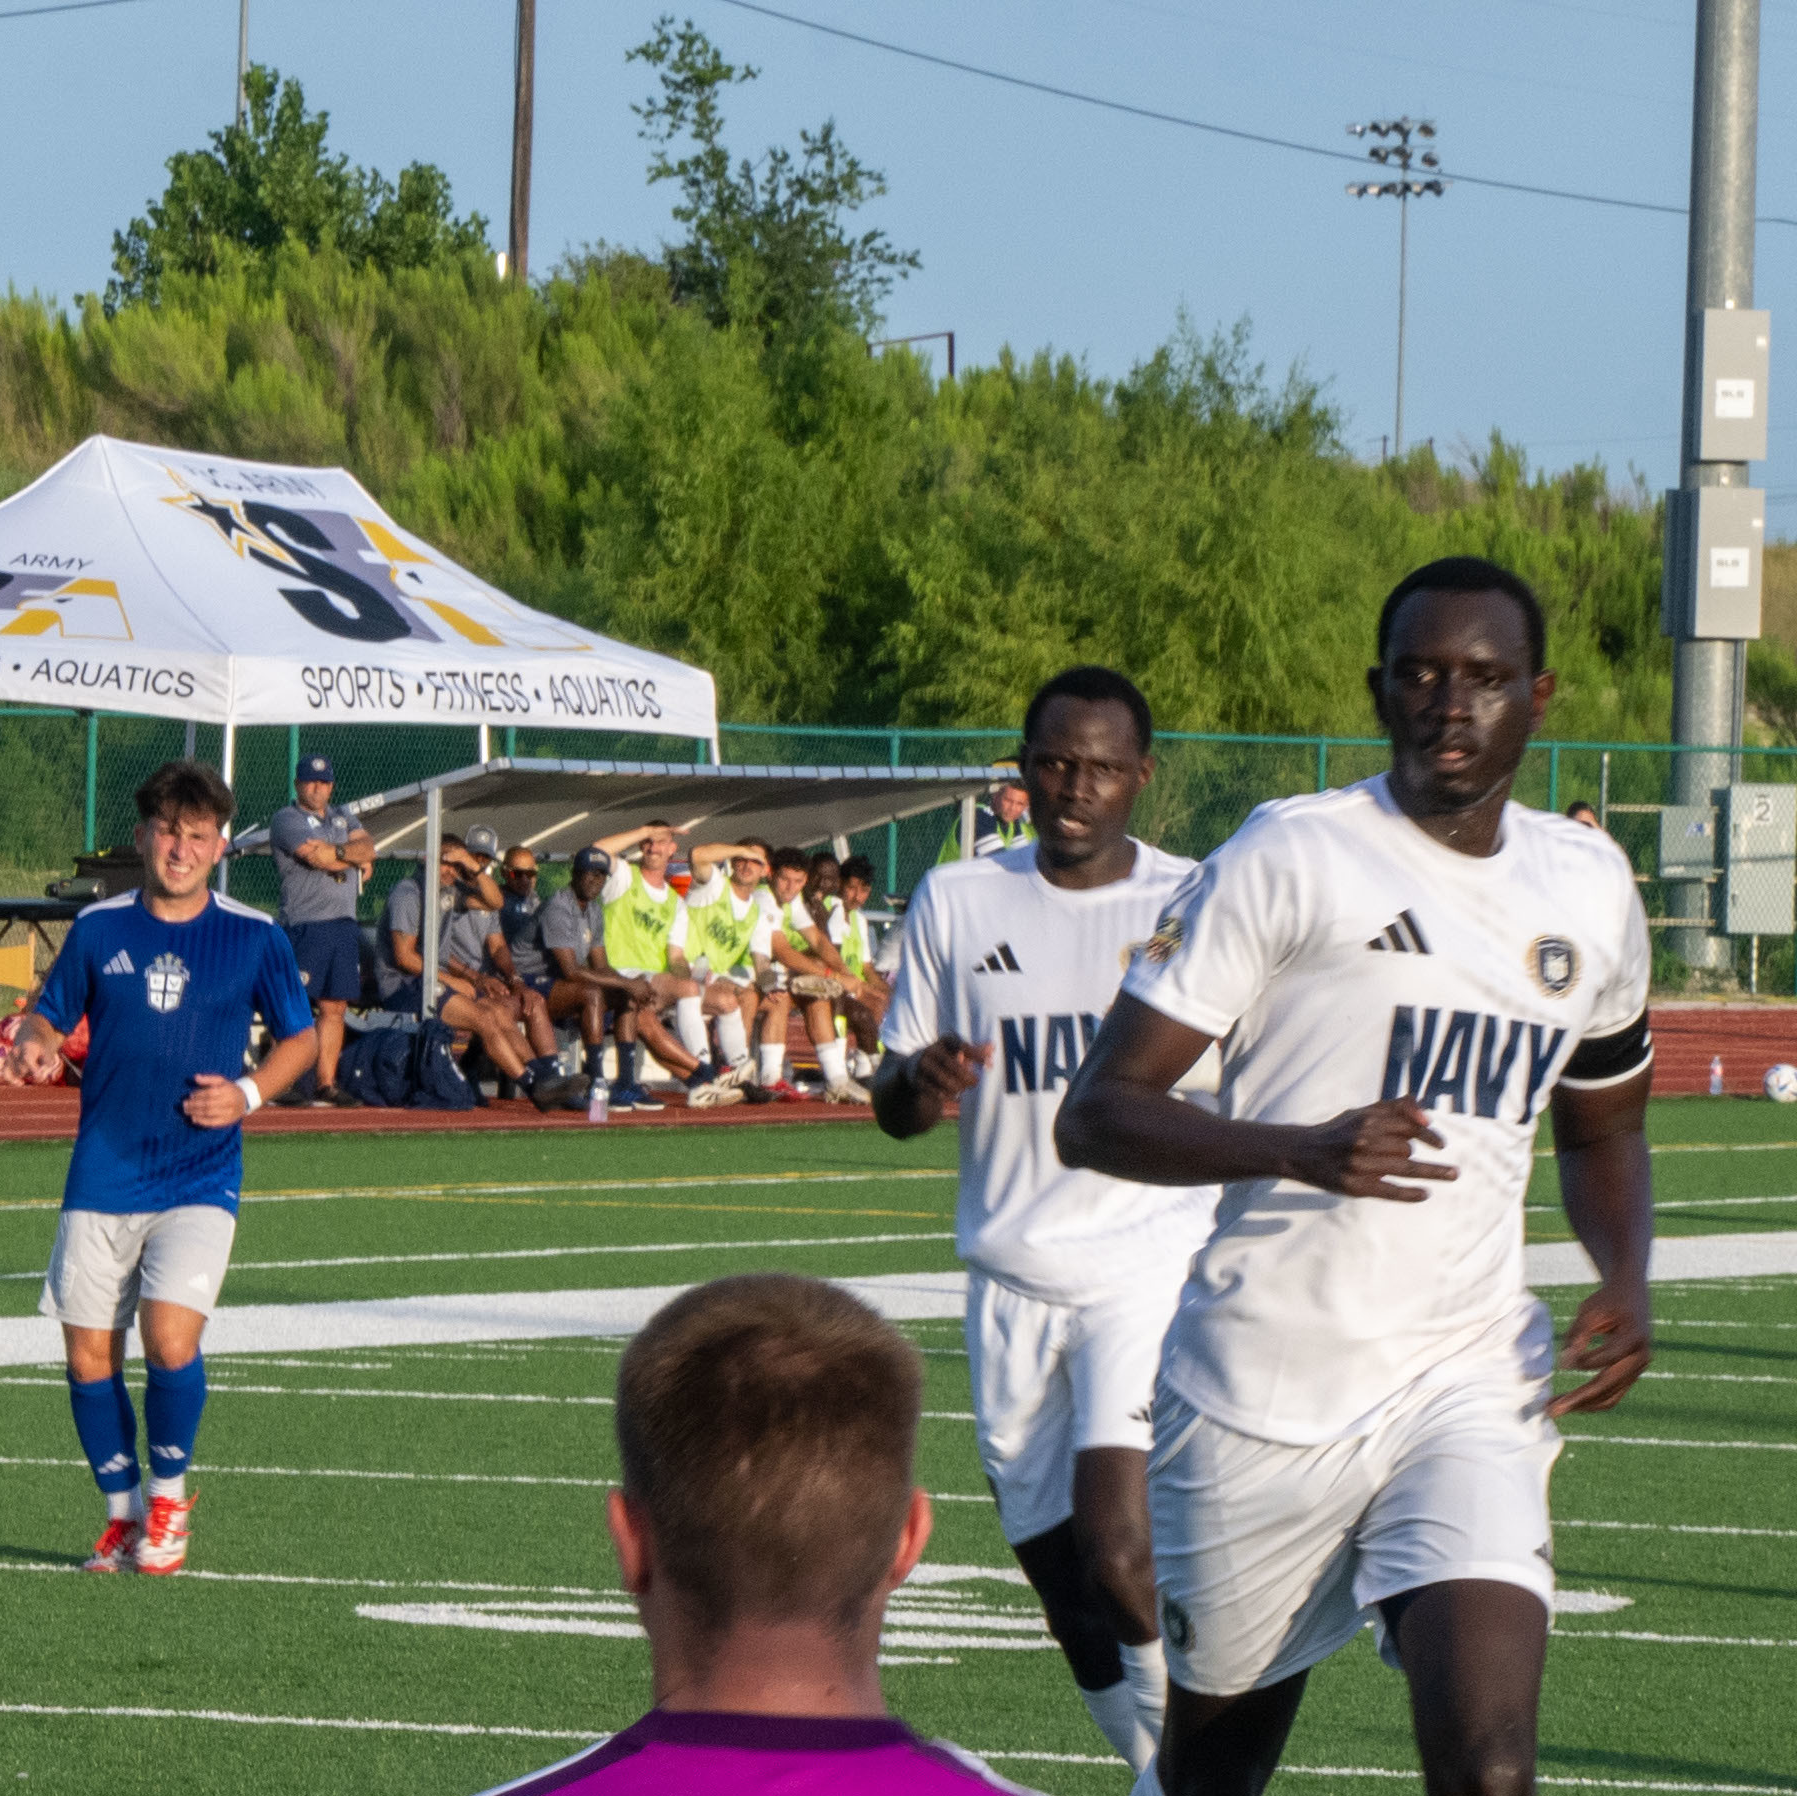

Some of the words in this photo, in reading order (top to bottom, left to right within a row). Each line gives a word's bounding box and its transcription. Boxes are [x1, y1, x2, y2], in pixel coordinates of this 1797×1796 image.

[9, 552, 95, 571] ARMY
[31, 657, 197, 698] AQUATICS
[301, 665, 407, 709] SPORTS
[424, 670, 532, 714] FITNESS
[549, 674, 663, 720] AQUATICS
[1380, 1003, 1571, 1126] NAVY
